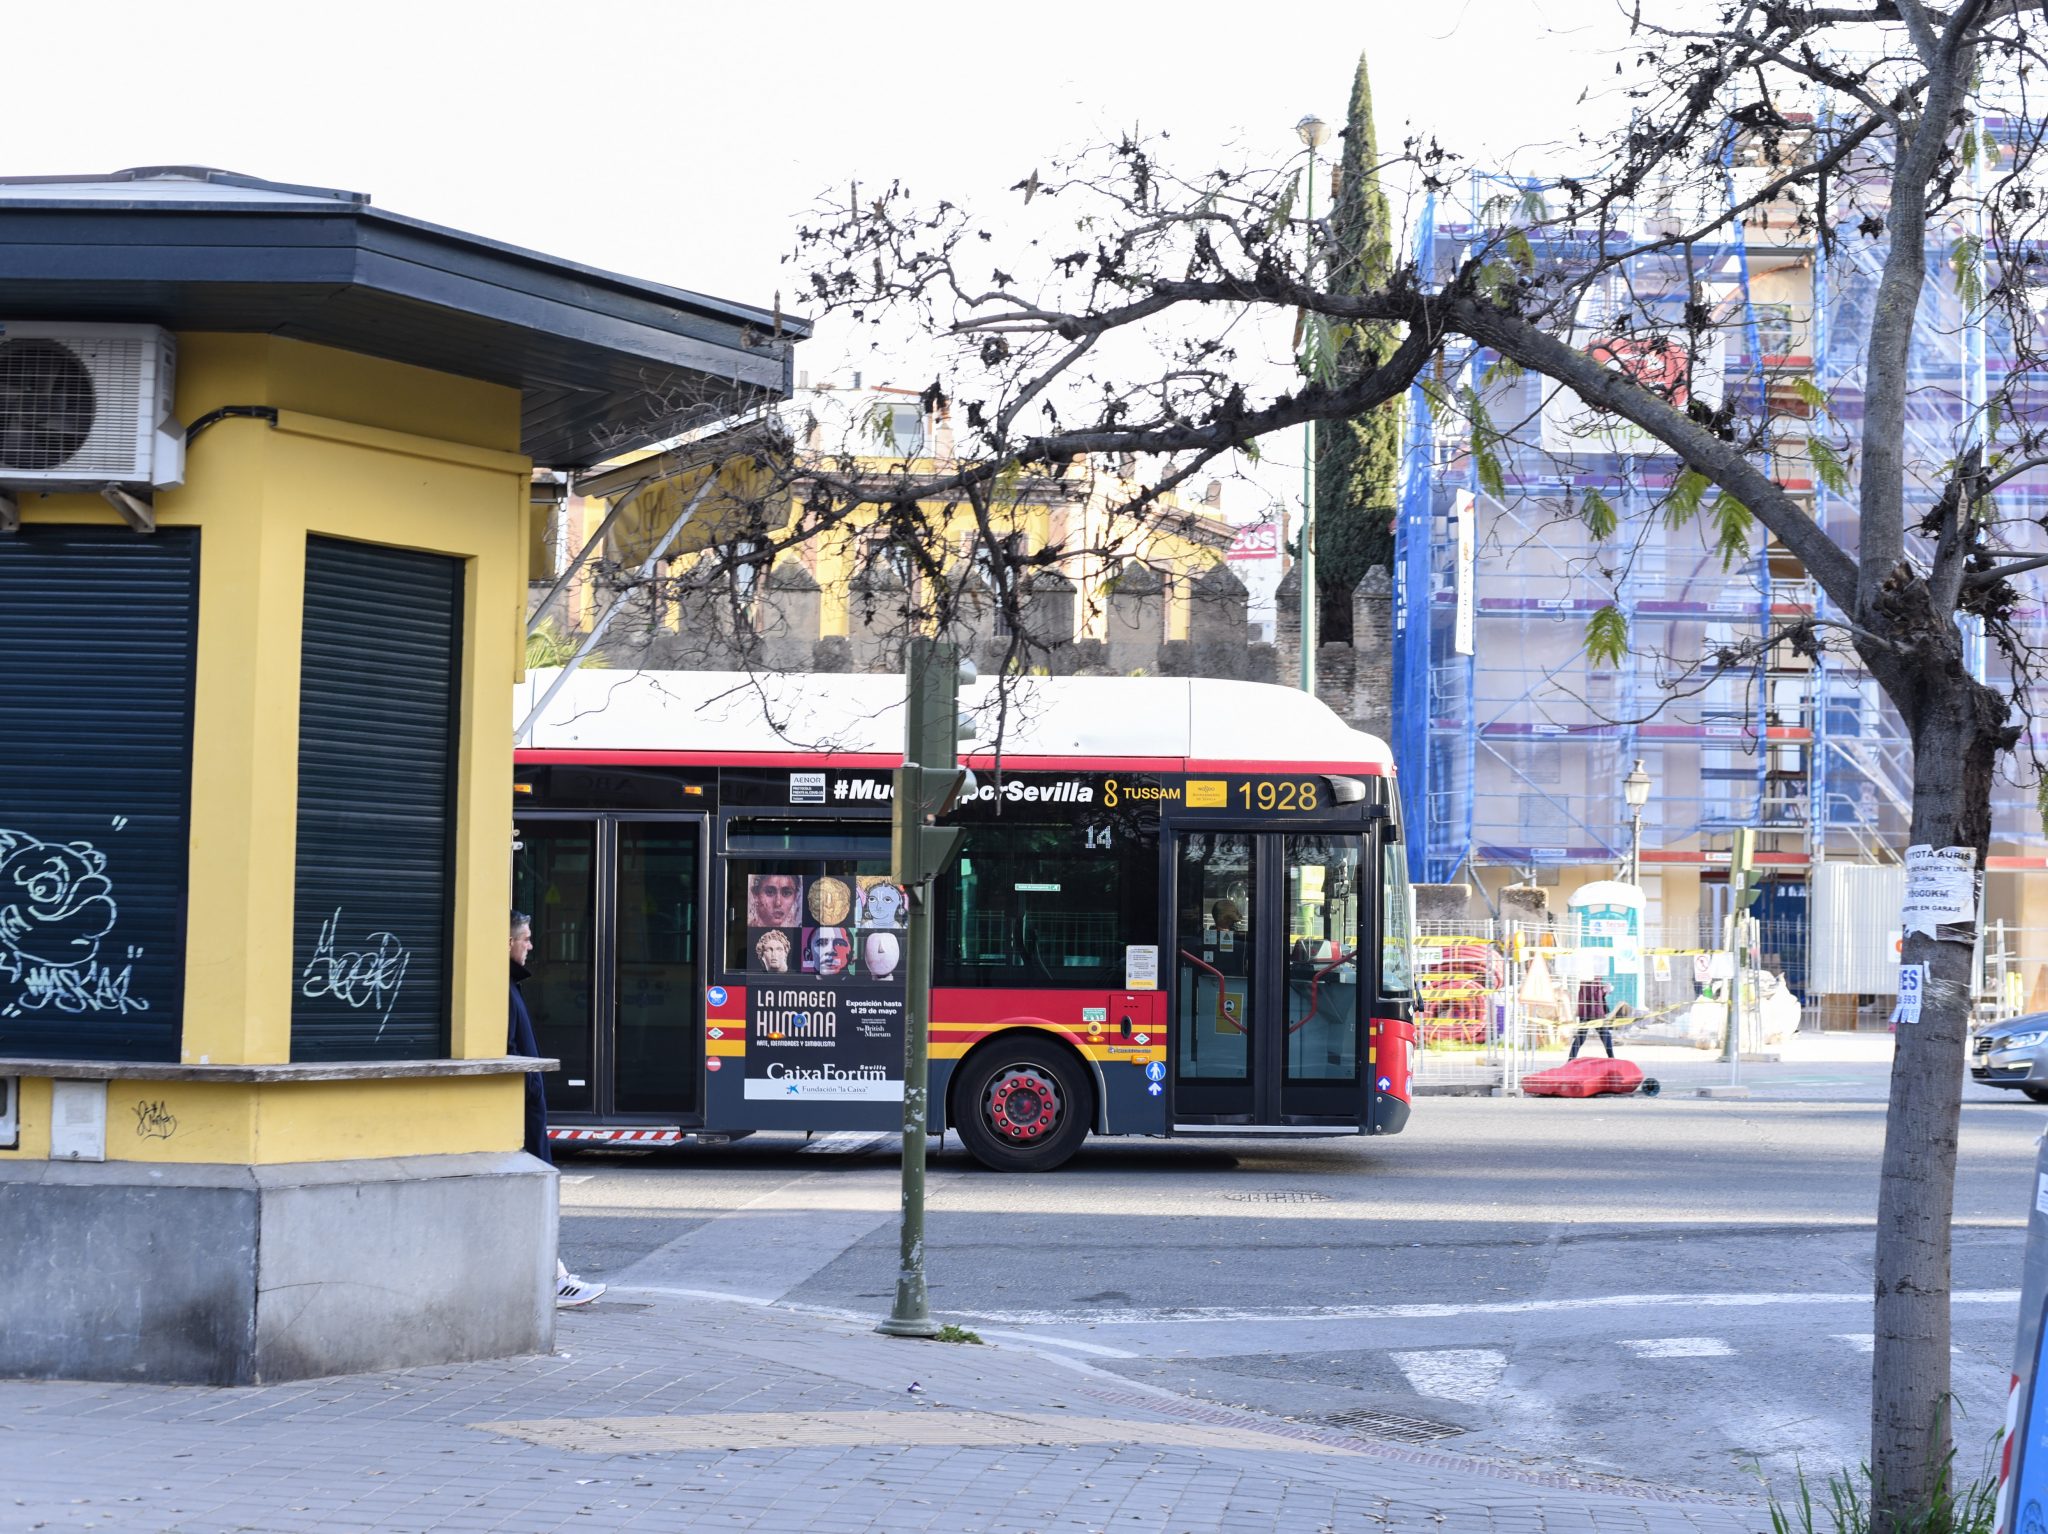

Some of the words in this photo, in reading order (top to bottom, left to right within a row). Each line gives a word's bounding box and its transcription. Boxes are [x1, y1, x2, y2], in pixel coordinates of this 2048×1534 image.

[1123, 787, 1181, 800] TUSSAM
[1239, 781, 1318, 811] 1928
[1085, 825, 1112, 849] 14
[1937, 851, 1971, 861] AURIS
[757, 990, 775, 1008] LA
[778, 990, 836, 1008] IMAGEN
[845, 999, 882, 1008] Exposición
[756, 1010, 836, 1038] HUMANA
[766, 1062, 887, 1081] CaixaForum
[802, 1085, 837, 1093] Fundación
